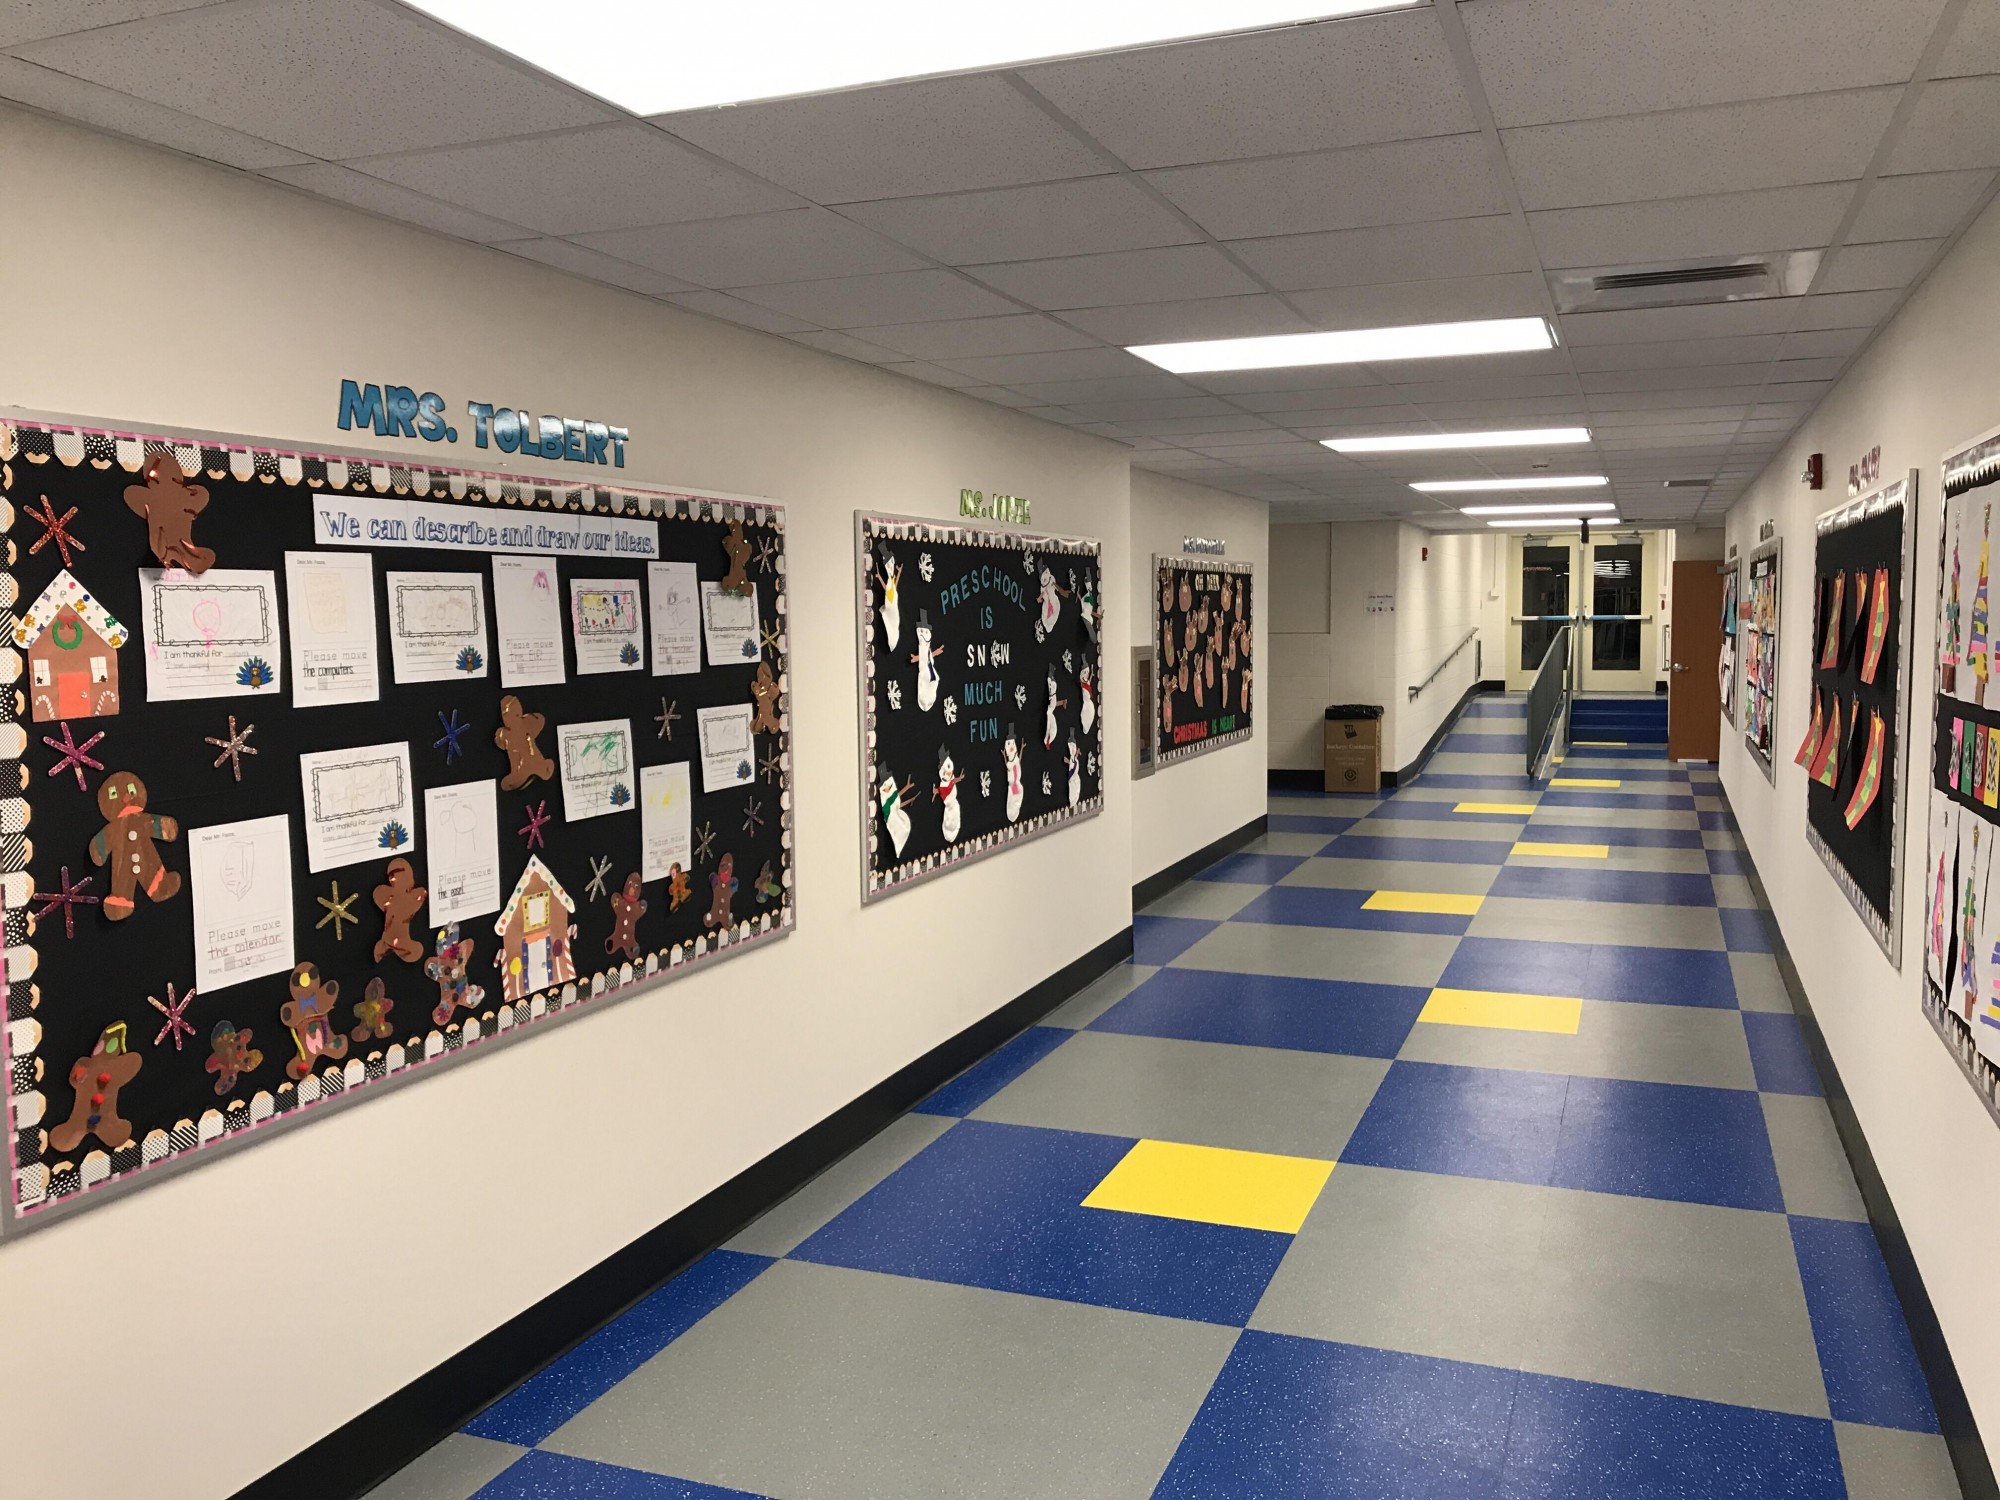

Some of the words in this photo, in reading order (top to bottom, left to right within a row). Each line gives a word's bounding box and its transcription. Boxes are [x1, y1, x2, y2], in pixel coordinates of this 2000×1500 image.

[337, 378, 458, 443] MRS.
[468, 400, 629, 468] TOLBERT
[960, 488, 987, 519] MS.
[319, 511, 360, 539] We
[367, 516, 407, 541] can
[412, 515, 498, 545] describe
[500, 524, 533, 548] and
[535, 525, 580, 550] draw
[582, 530, 611, 551] our
[614, 530, 655, 554] ideas.
[940, 564, 1026, 615] PRESCHOOL
[980, 606, 993, 630] IS
[183, 650, 210, 658] thankful
[303, 649, 337, 662] Please
[342, 651, 367, 660] move
[967, 639, 1010, 669] SNW
[302, 661, 316, 678] the
[964, 680, 1003, 706] MUCH
[970, 717, 998, 743] FUN
[1173, 720, 1208, 745] CHRISTMAS
[1211, 718, 1217, 735] IS
[438, 874, 466, 885] Please
[470, 868, 491, 878] move
[437, 886, 448, 900] the
[208, 928, 246, 944] Please
[252, 920, 281, 933] move
[208, 945, 230, 960] the
